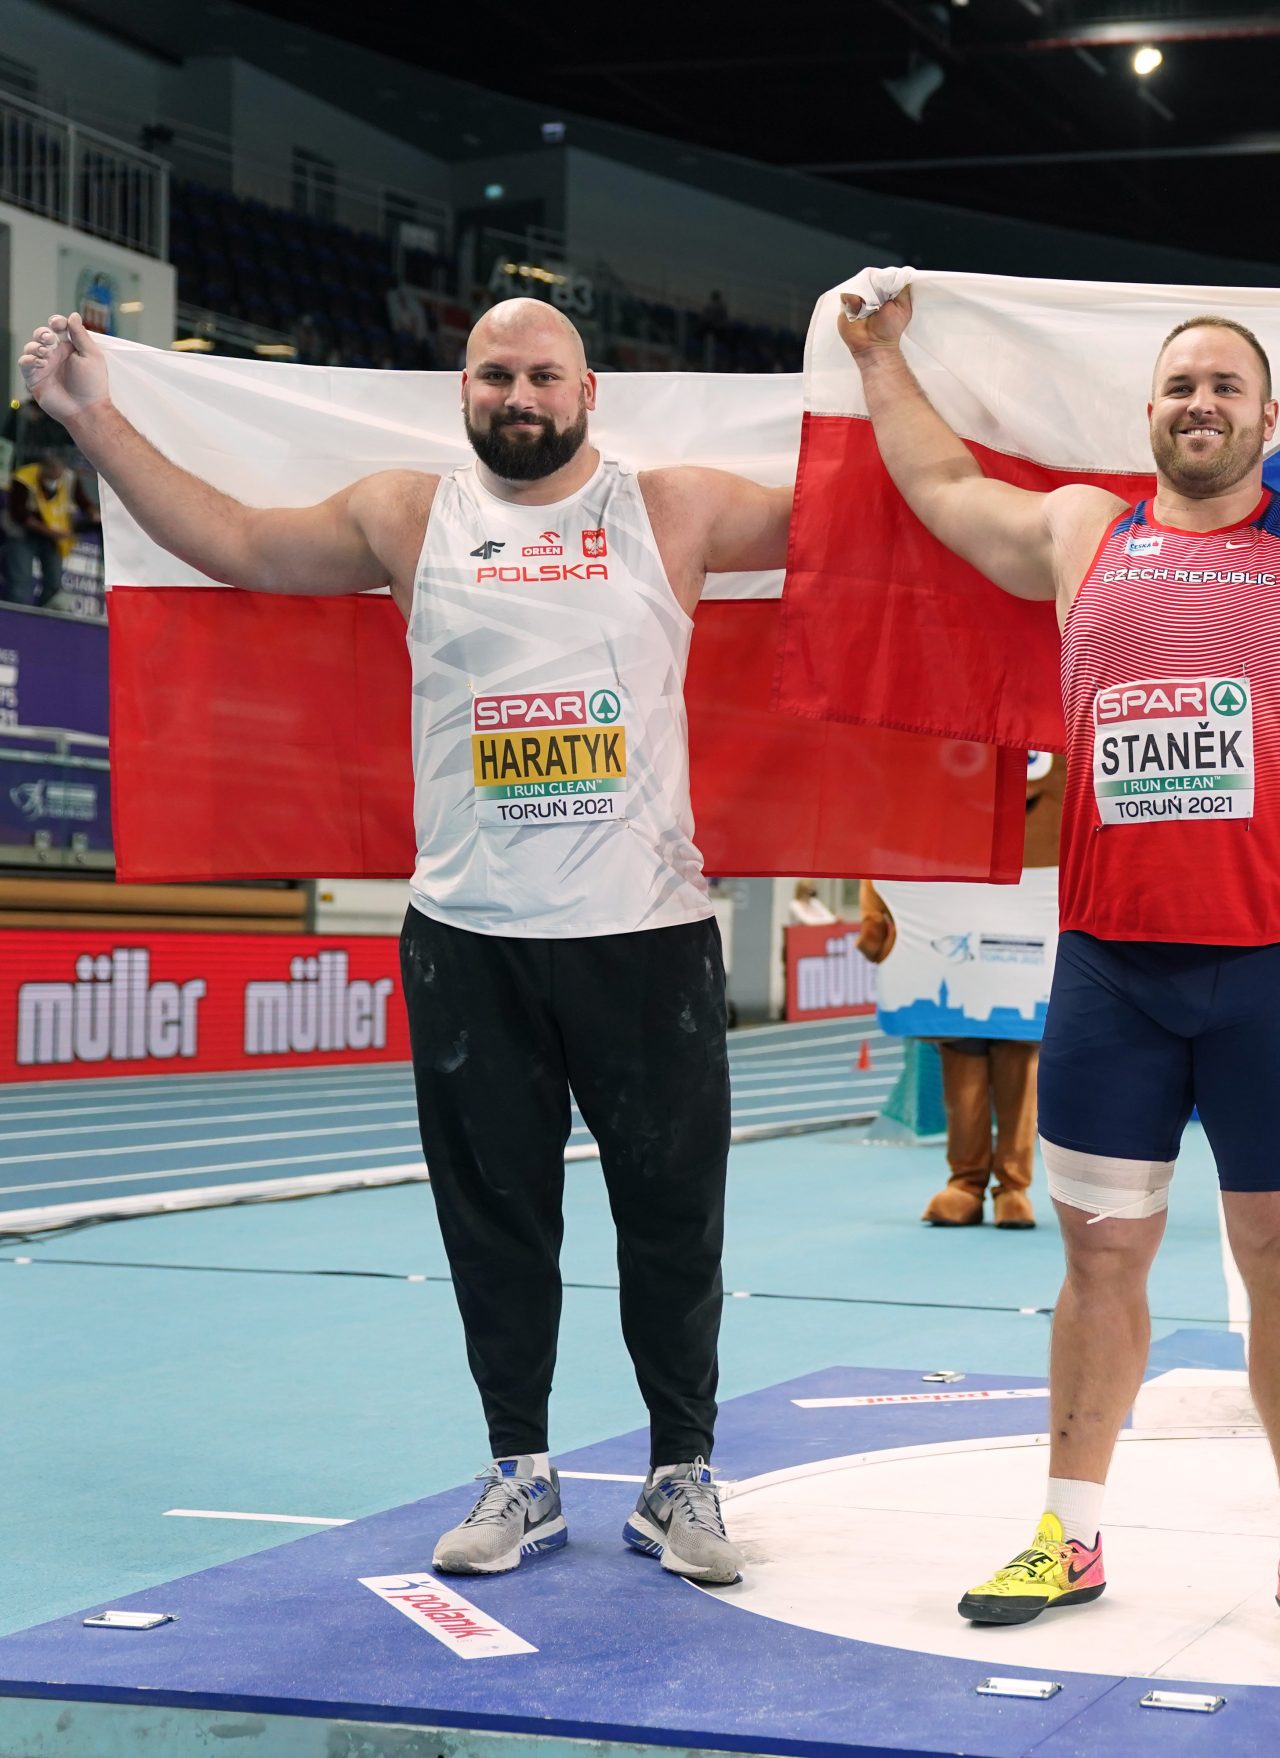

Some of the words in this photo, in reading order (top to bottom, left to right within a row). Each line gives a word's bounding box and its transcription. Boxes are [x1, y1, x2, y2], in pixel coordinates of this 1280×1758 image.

[523, 546, 561, 556] ORLEN
[477, 564, 608, 583] POLSKA
[1103, 568, 1168, 583] CZECH
[1174, 570, 1277, 586] REPUBLIC
[476, 696, 583, 726] SPAR
[1099, 687, 1204, 719] SPAR
[479, 733, 622, 780] HARATYK
[1101, 722, 1244, 776] STANĚK
[514, 782, 546, 796] RUN
[1131, 780, 1162, 792] RUN
[497, 798, 568, 821] TORUŃ
[573, 798, 614, 817] 2021
[1115, 796, 1182, 818] TORUŃ
[1188, 797, 1233, 814] 2021
[17, 947, 207, 1065] müller
[244, 950, 394, 1055] müller
[386, 1593, 500, 1639] polanik
